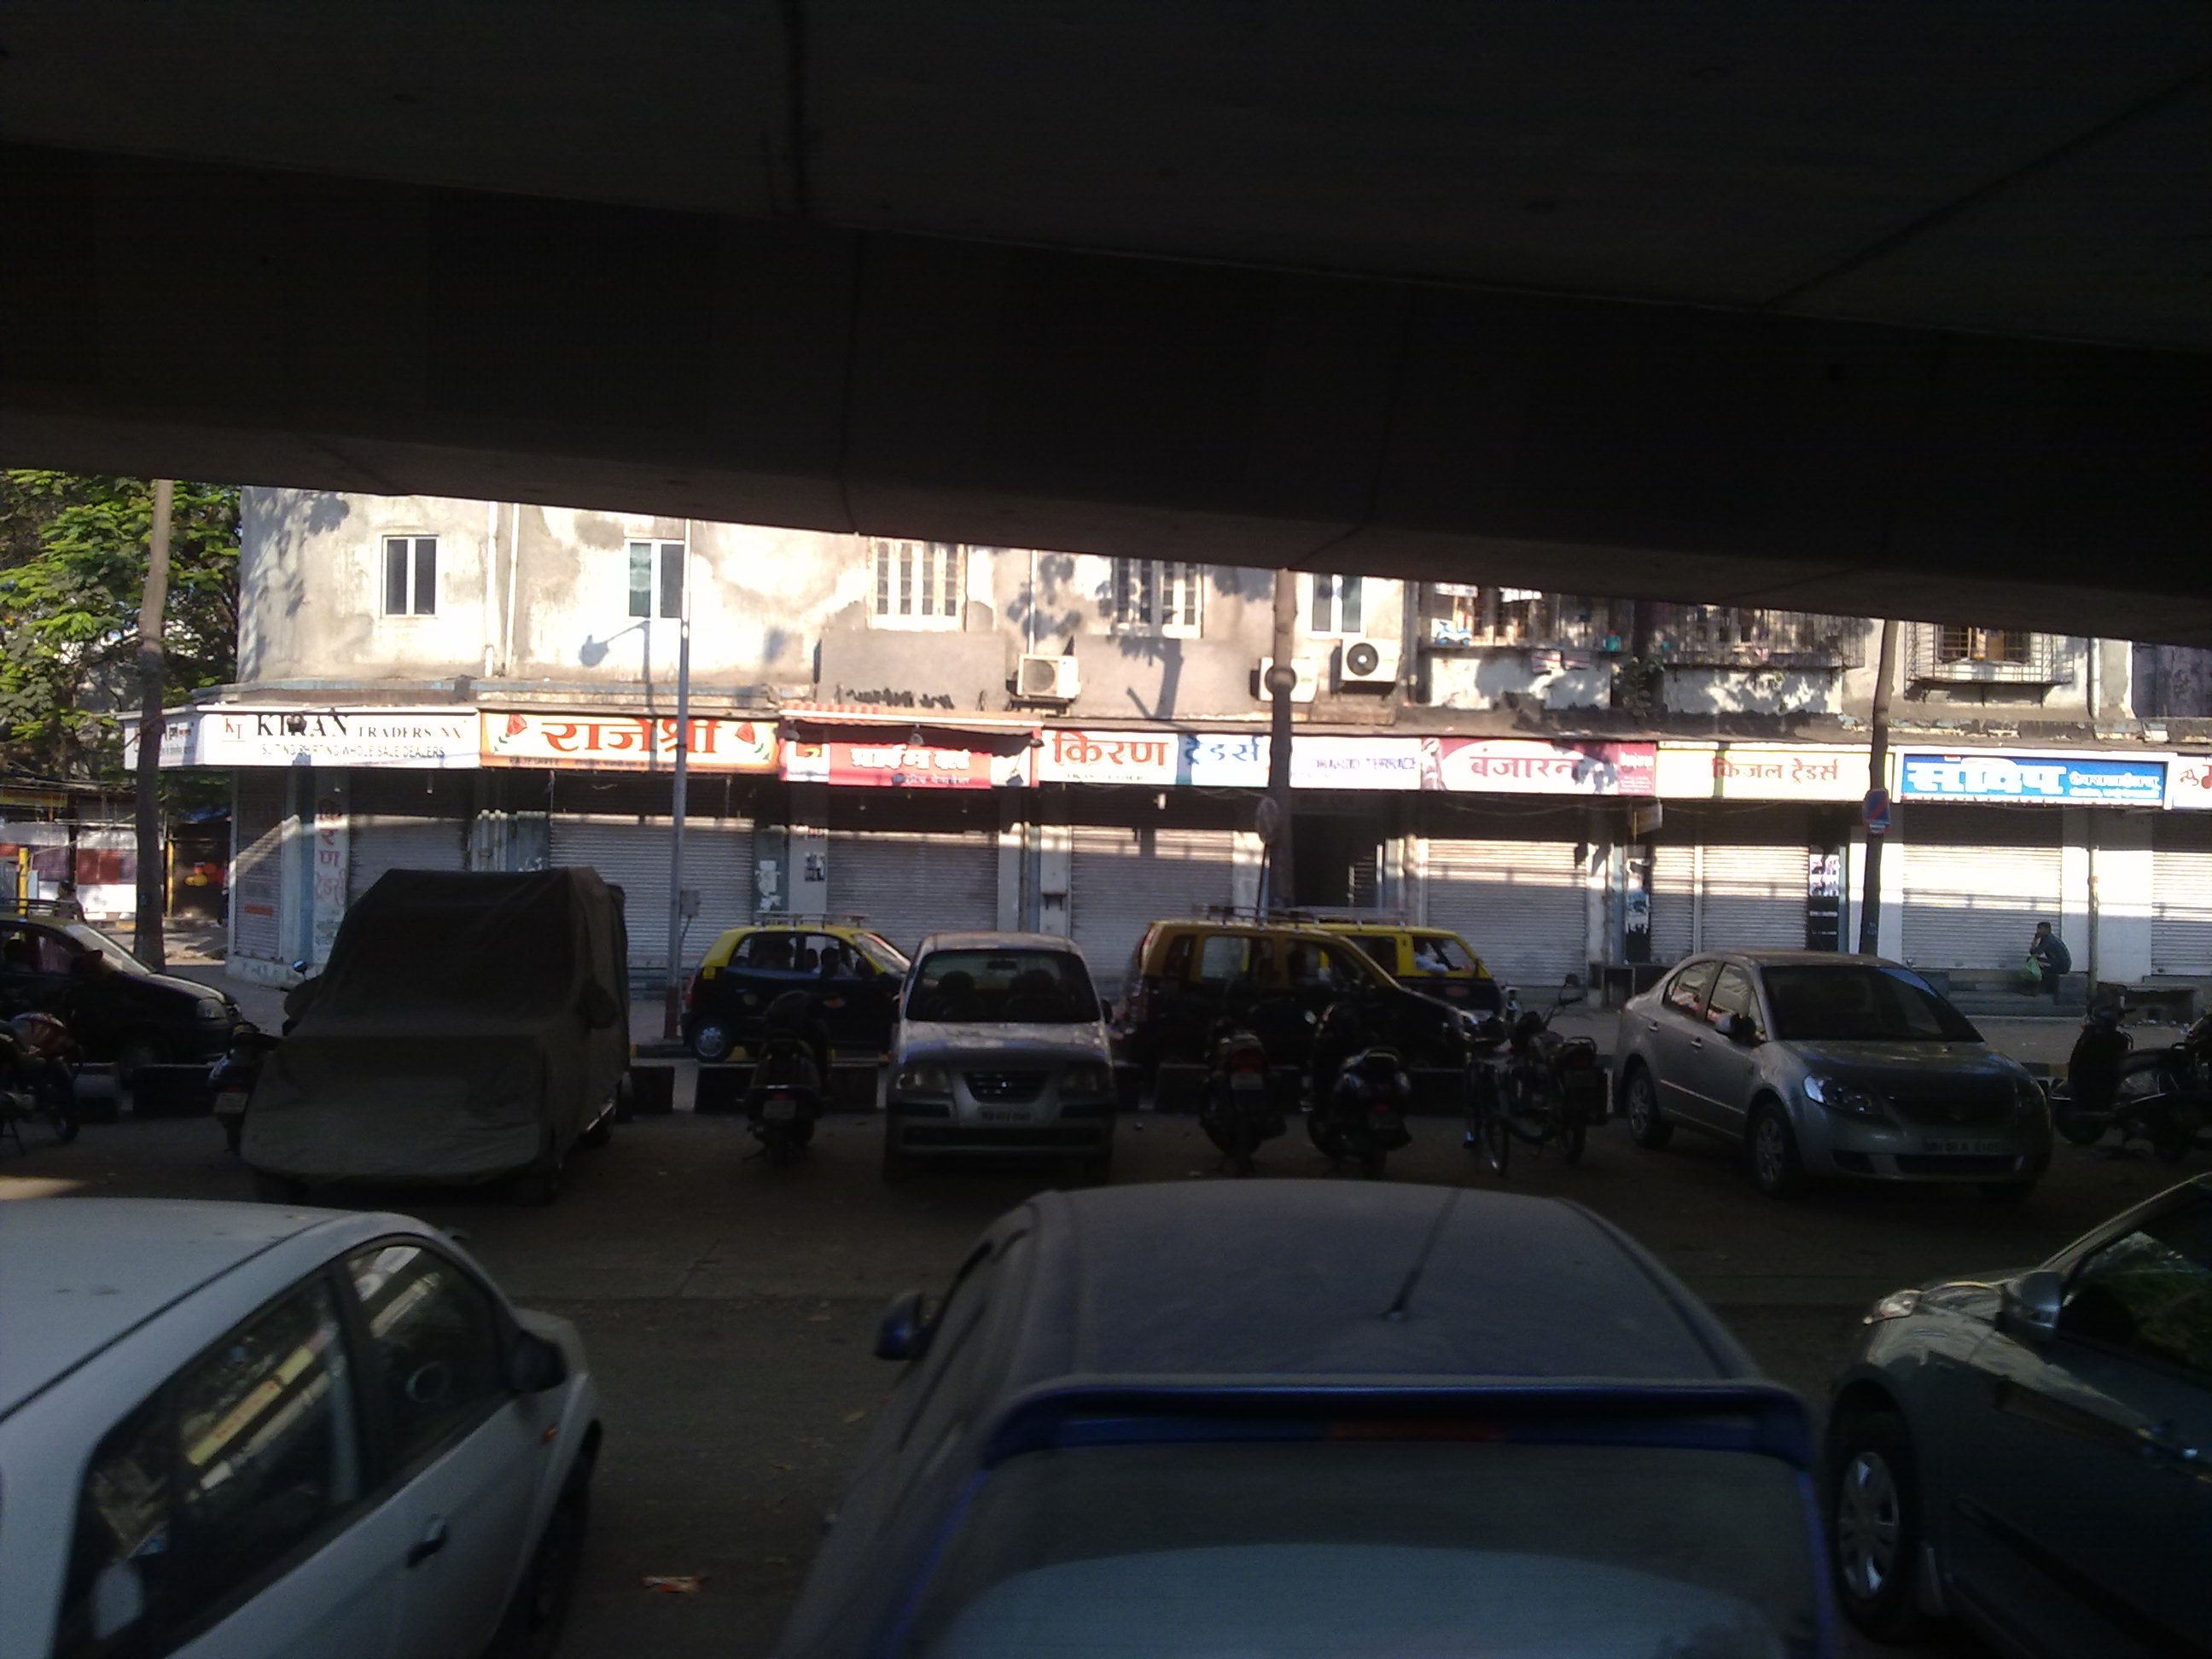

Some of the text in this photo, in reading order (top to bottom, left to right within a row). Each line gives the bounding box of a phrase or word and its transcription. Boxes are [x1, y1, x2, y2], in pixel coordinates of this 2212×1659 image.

[358, 726, 432, 738] TRADERS
[403, 746, 445, 759] DEALERS
[1052, 731, 1167, 766] किरण
